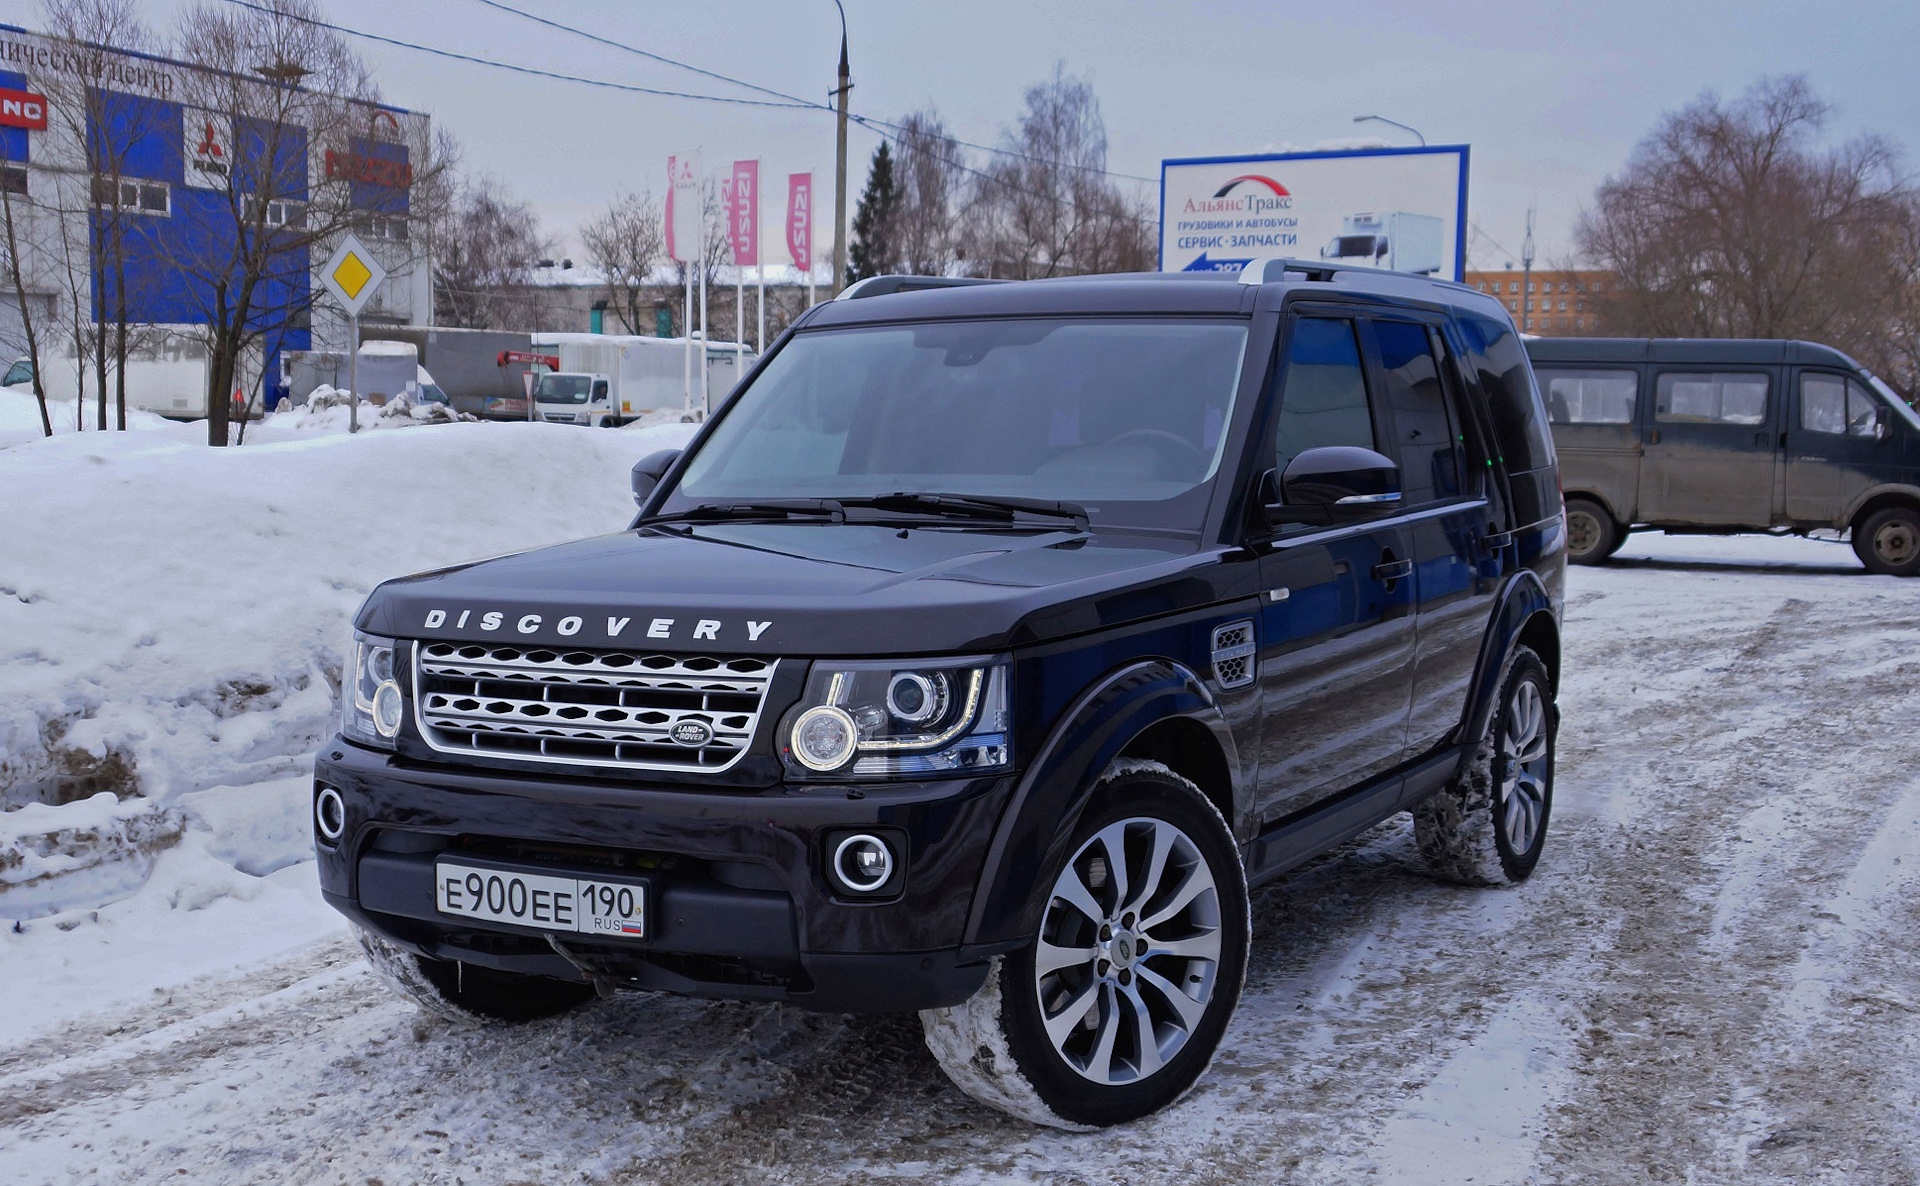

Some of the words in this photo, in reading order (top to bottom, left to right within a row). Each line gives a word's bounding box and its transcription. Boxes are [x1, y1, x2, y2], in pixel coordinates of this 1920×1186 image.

[112, 62, 173, 99] центр
[1178, 220, 1234, 231] ГРУЗОВИКИ
[1236, 220, 1243, 229] И
[1246, 217, 1298, 228] АВТОБУСЫ
[1178, 235, 1223, 249] СЕРВИС
[1231, 233, 1298, 247] ЗАПЧАСТИ
[424, 609, 773, 642] DISCOVERY
[582, 884, 634, 919] 190
[594, 917, 621, 931] RUS
